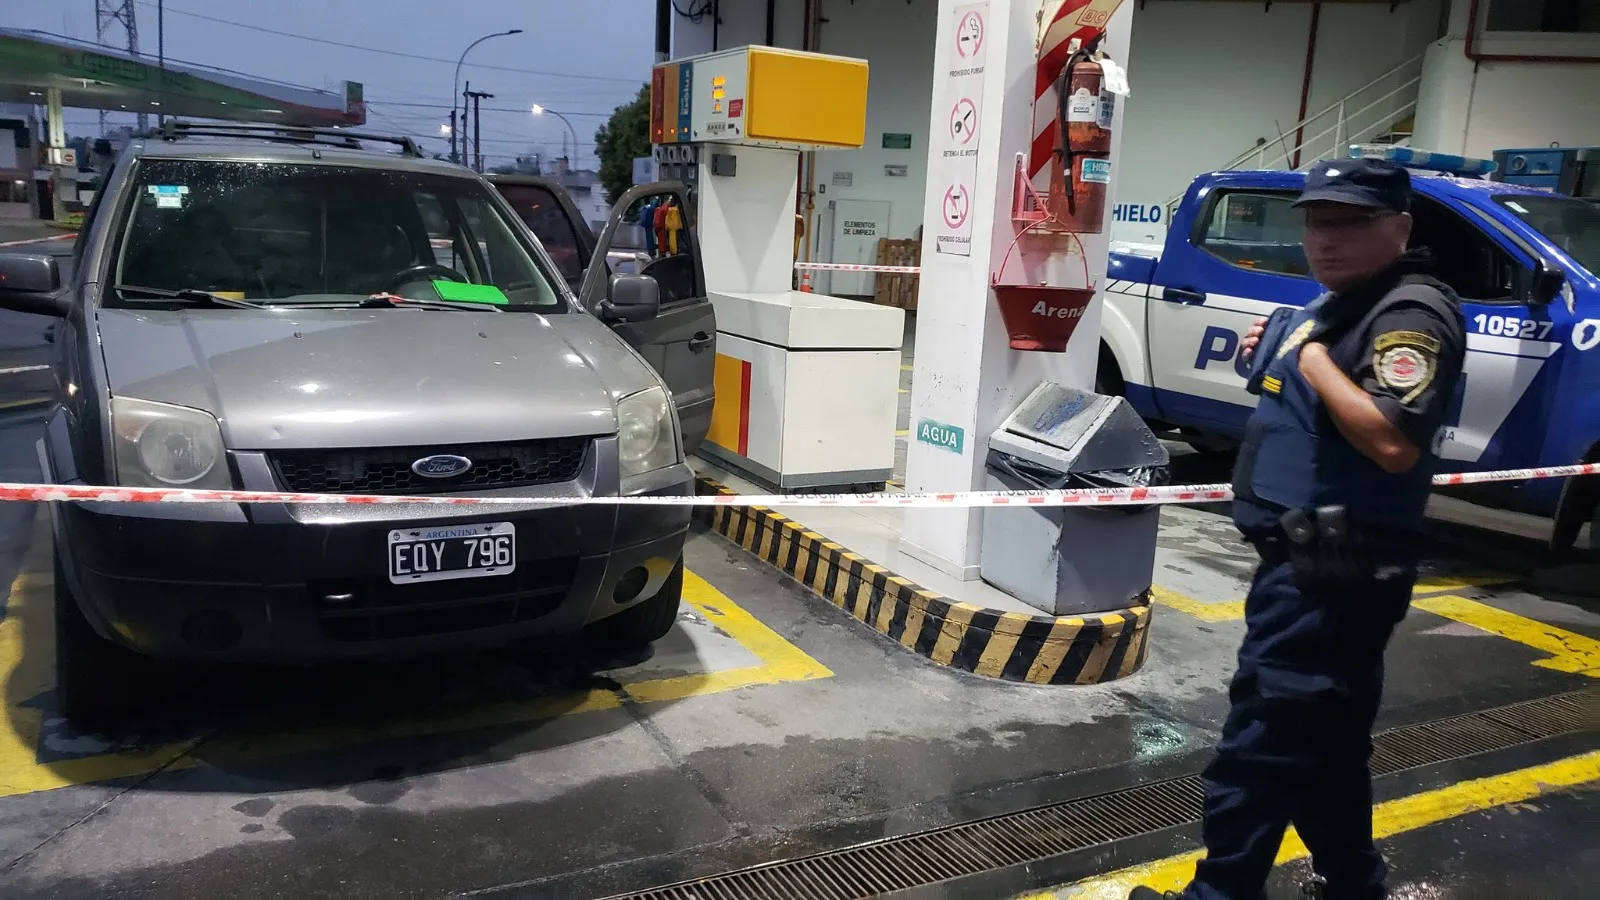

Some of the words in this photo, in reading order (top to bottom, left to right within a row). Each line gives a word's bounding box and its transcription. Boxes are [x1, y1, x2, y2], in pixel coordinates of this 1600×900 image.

[1112, 204, 1161, 223] HIELO
[1473, 313, 1554, 340] 10527
[921, 424, 957, 447] AGUA
[428, 460, 457, 472] Ford
[426, 528, 478, 540] ARGENTINA
[395, 541, 446, 575] EQY
[463, 536, 510, 568] 796
